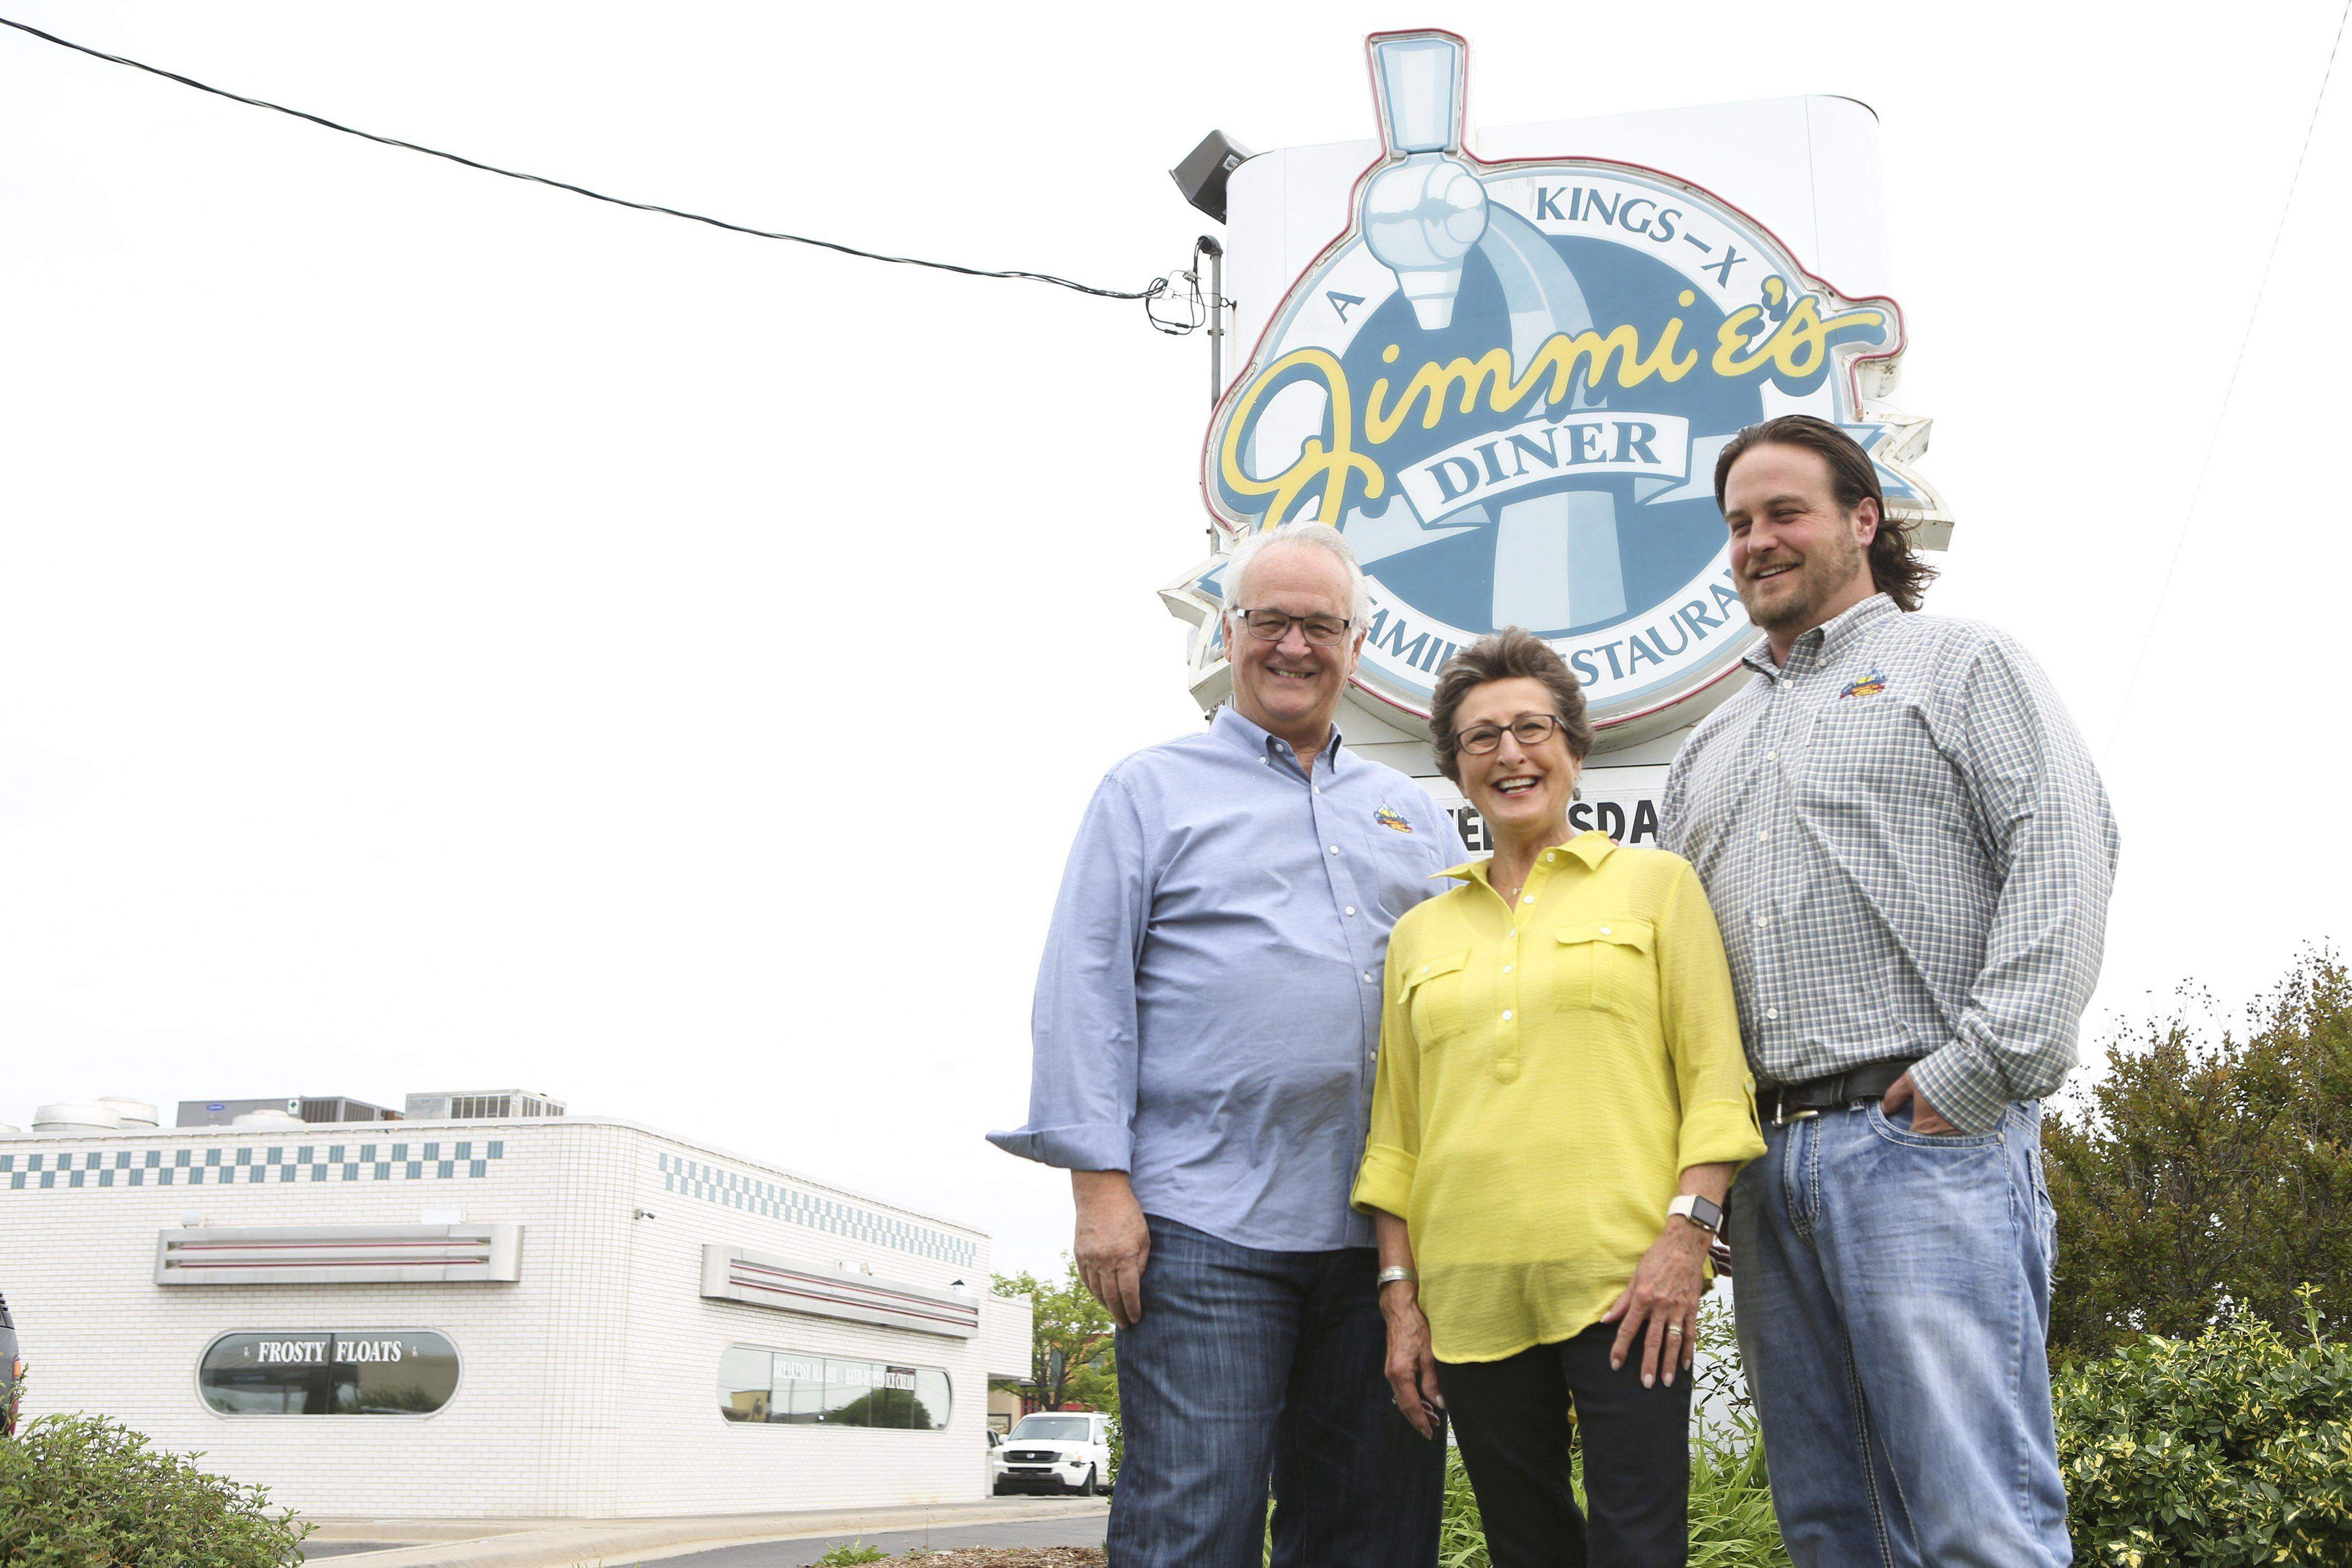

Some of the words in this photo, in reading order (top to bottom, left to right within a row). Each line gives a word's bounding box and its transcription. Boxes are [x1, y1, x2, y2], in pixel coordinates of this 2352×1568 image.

[1326, 290, 1367, 324] A
[1221, 277, 1882, 531] Jimmie's
[1425, 420, 1661, 505] DINER
[1558, 568, 1741, 687] STAURA
[257, 1341, 326, 1363] FROSTY
[335, 1340, 403, 1363] FLOATS
